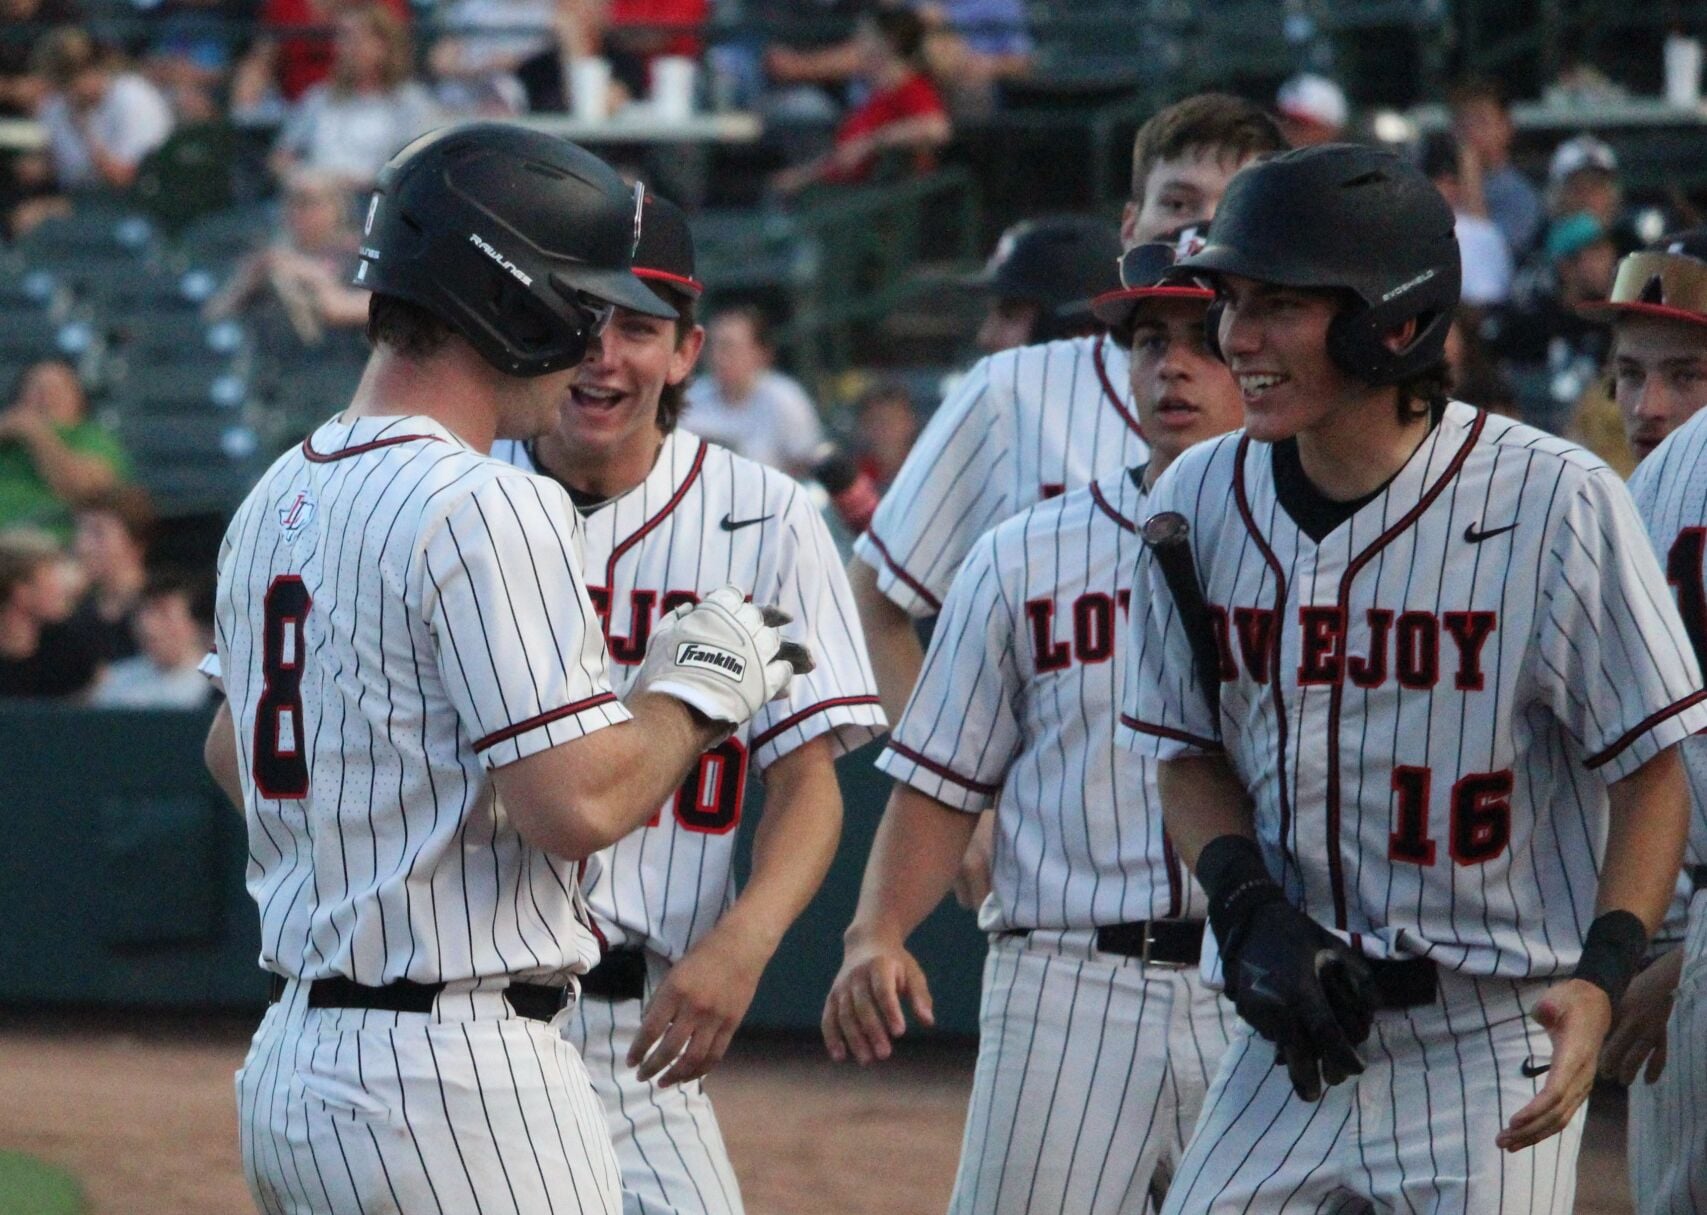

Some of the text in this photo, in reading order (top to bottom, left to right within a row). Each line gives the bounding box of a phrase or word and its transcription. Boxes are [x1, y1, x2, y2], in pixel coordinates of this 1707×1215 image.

[469, 233, 533, 287] RAWLINGS
[679, 644, 743, 675] Franklin
[1024, 588, 1131, 675] LO
[252, 574, 313, 800] 8
[1388, 765, 1514, 866] 16
